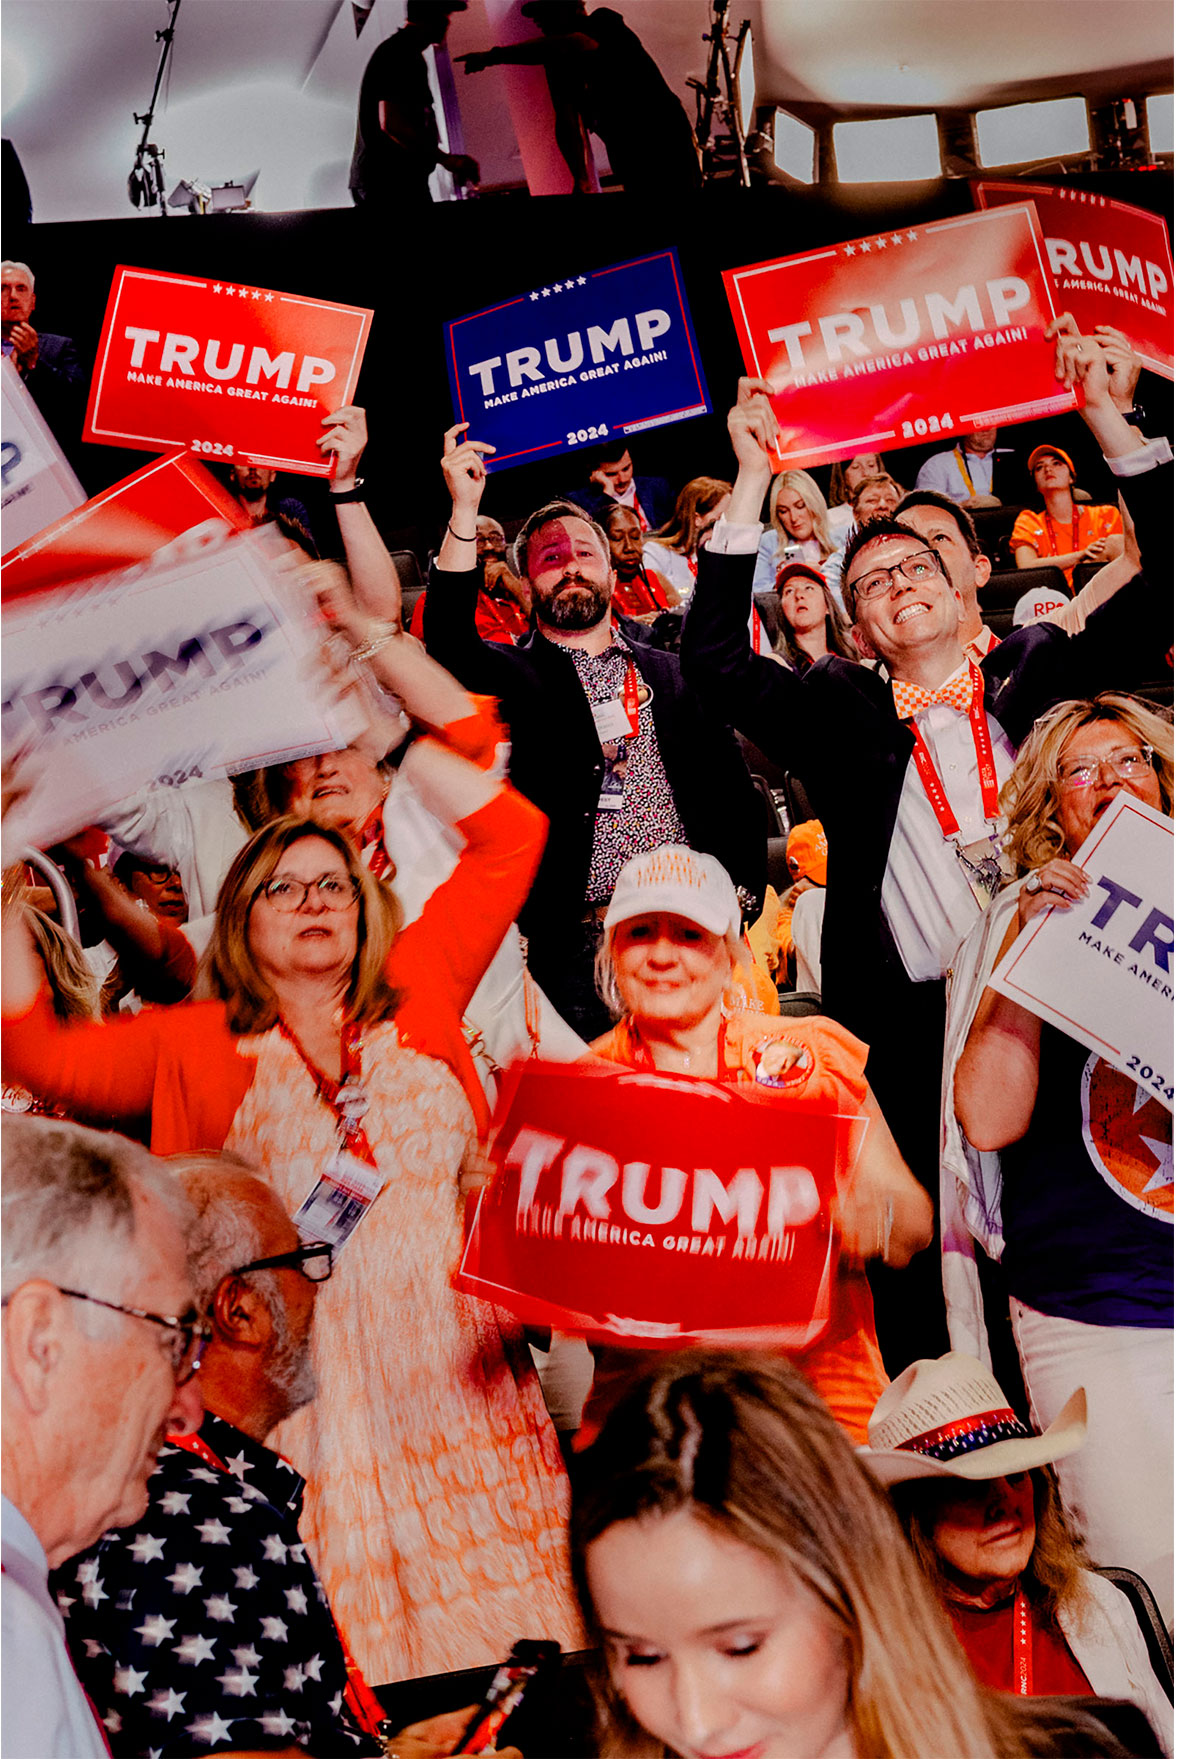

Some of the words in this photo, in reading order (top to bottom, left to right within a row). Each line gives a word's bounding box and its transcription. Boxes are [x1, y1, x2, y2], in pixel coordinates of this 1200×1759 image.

[1063, 278, 1111, 294] AMERICA
[1113, 286, 1138, 304] GREAT
[767, 276, 1031, 375] TRUMP
[124, 326, 337, 392] TRUMP
[468, 309, 671, 396] TRUMP
[794, 369, 838, 388] MAKE
[843, 355, 914, 378] AMERICA
[918, 339, 968, 362] GREAT
[973, 325, 1028, 350] AGAIN!
[126, 370, 163, 386] MAKE
[166, 377, 223, 395] AMERICA
[227, 386, 269, 402] GREAT
[272, 392, 318, 409] AGAIN!
[484, 391, 519, 409] MAKE
[521, 375, 577, 398] AMERICA
[579, 363, 620, 382] GREAT
[623, 350, 668, 371] AGAIN!
[190, 439, 234, 457] 2024
[566, 424, 609, 446] 2024
[901, 412, 954, 439] 2024
[1, 621, 263, 737] RUMP
[63, 713, 141, 747] AMERICA
[146, 691, 200, 717] GREAT
[1078, 931, 1125, 965] MAKE
[1126, 1055, 1174, 1100] 2024
[505, 1125, 820, 1239] TRUMP
[571, 1214, 655, 1248] AMERICA
[662, 1233, 726, 1257] GREAT
